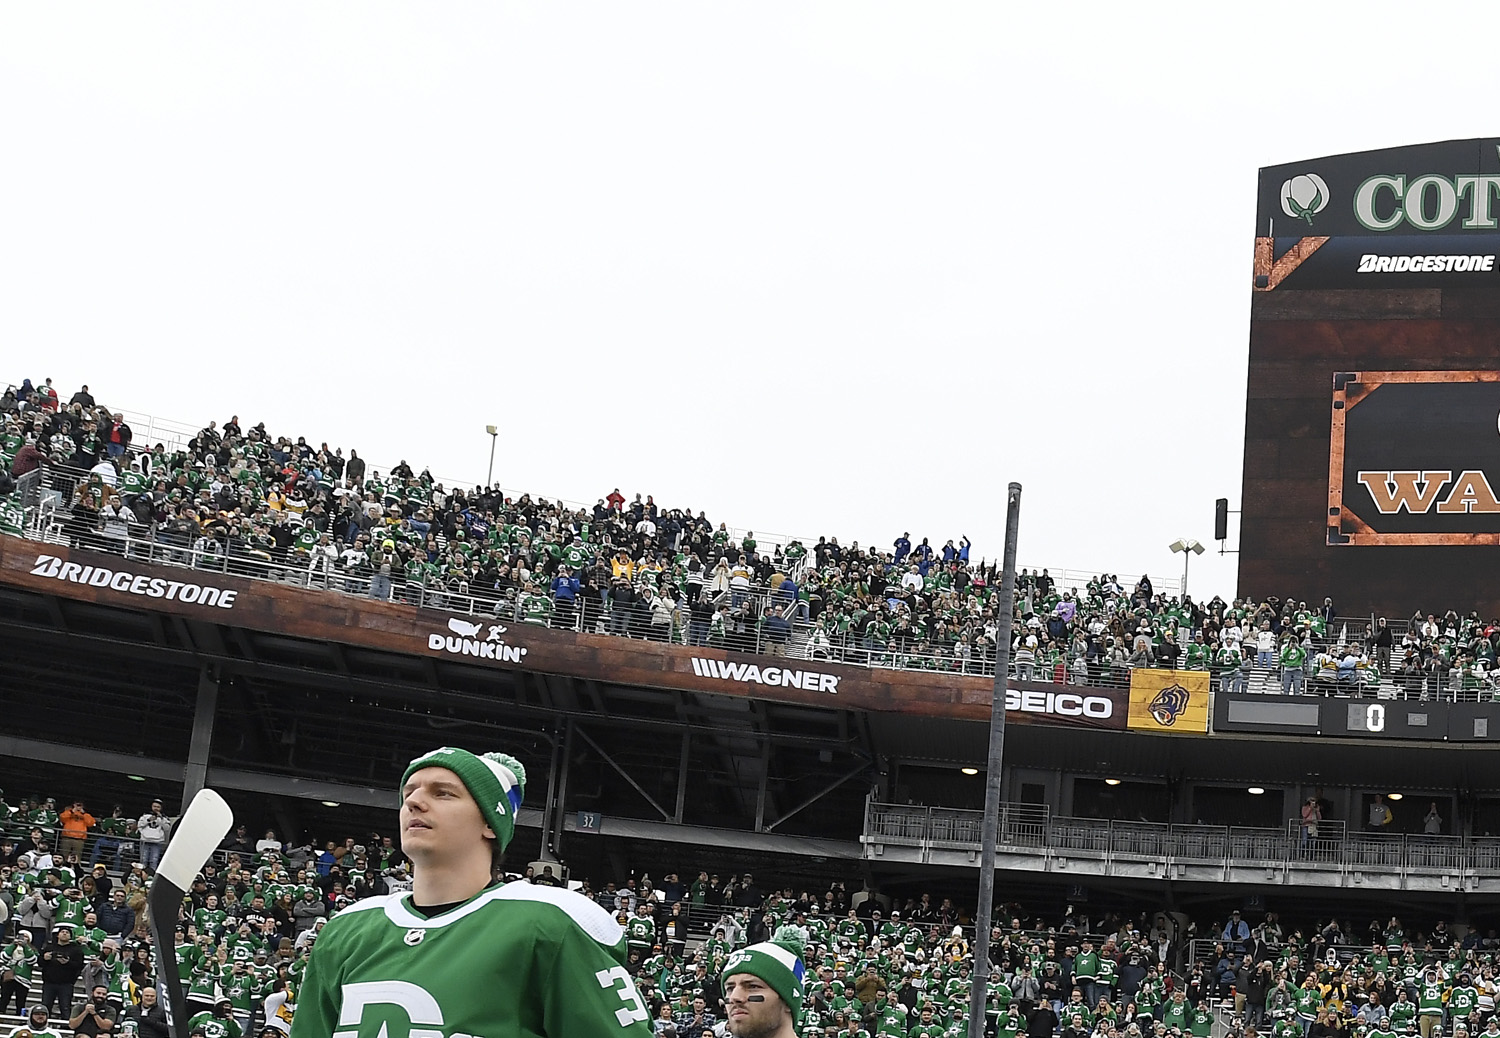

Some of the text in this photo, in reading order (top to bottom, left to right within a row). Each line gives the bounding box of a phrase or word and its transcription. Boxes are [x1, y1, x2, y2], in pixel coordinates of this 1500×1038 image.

[1356, 253, 1496, 273] BRIDGESTONE
[30, 555, 238, 609] BRIDGESTONE
[705, 659, 840, 693] WAGNER
[1366, 703, 1386, 732] 0
[582, 815, 595, 828] 32
